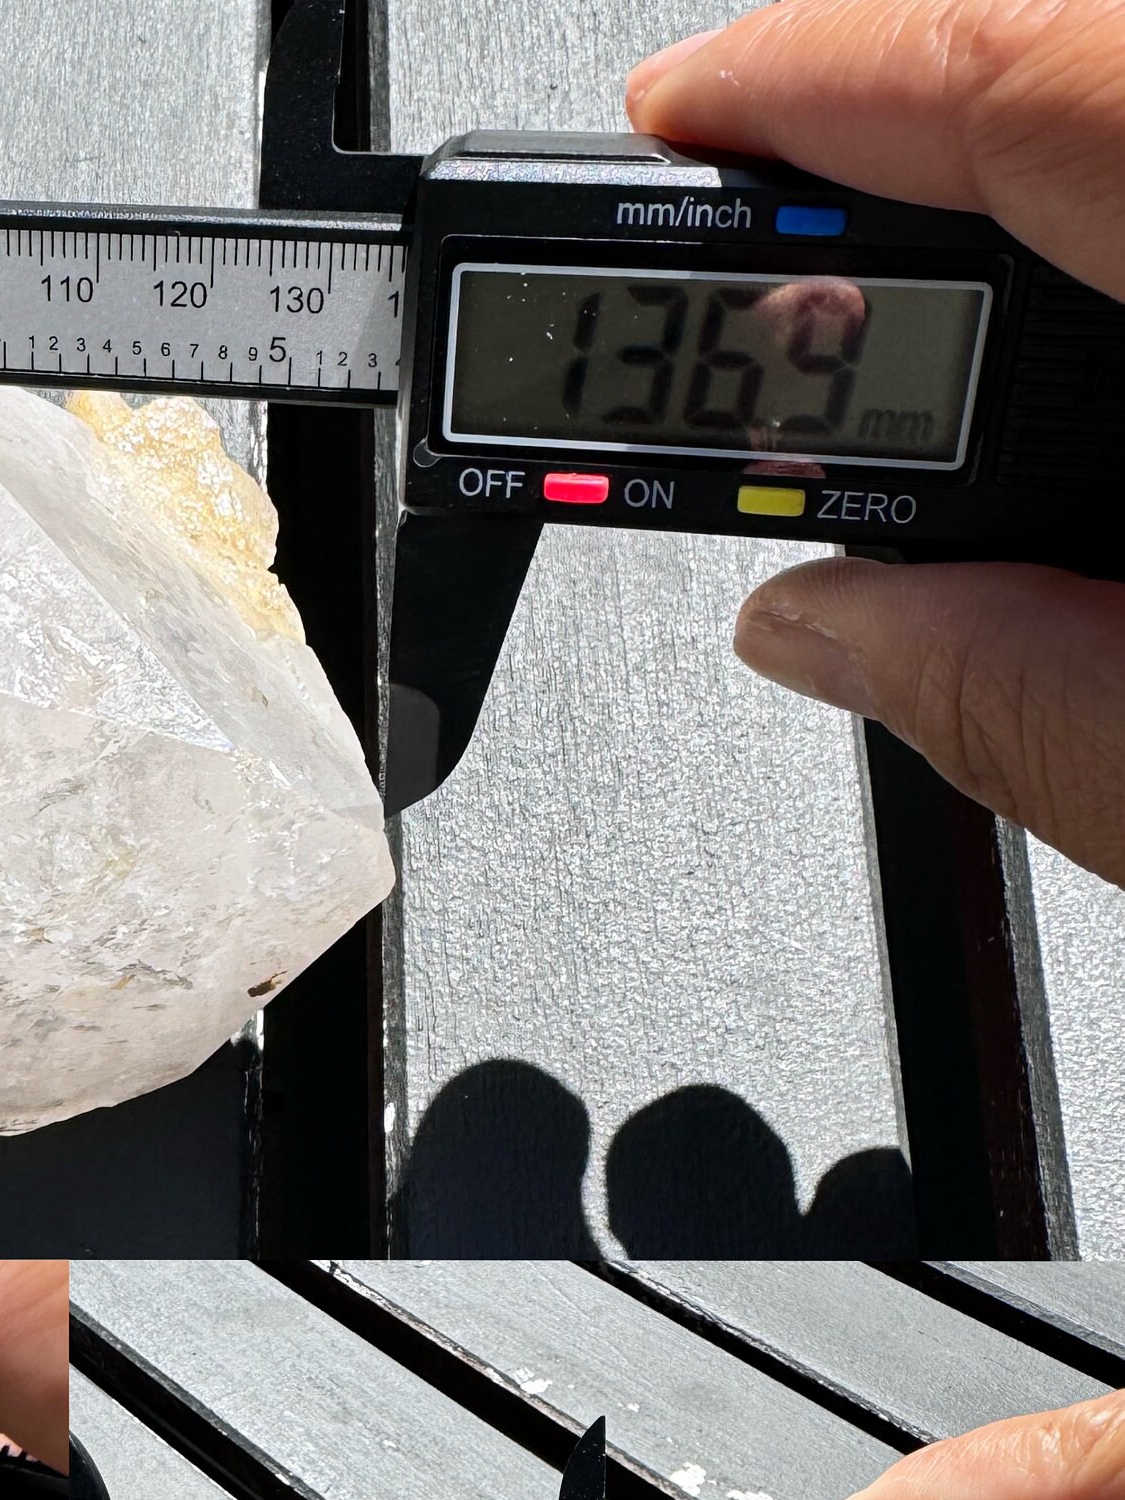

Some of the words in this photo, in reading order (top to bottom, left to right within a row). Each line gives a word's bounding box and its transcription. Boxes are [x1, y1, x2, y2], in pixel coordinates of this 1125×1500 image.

[617, 196, 750, 227] mm/inch
[41, 274, 93, 303] 110
[153, 280, 207, 309] 120
[270, 285, 324, 314] 130
[28, 335, 35, 350] 1
[49, 336, 58, 351] 2
[76, 337, 86, 352] 3
[102, 339, 112, 353] 4
[132, 341, 142, 355] 5
[160, 342, 171, 357] 6
[189, 343, 199, 358] 7
[218, 345, 228, 360] 8
[248, 346, 258, 361] 9
[269, 336, 286, 363] 5
[316, 350, 323, 366] 1
[337, 351, 348, 367] 2
[368, 353, 377, 368] 3
[861, 408, 933, 440] mm
[460, 468, 525, 498] OFF
[625, 480, 673, 508] ON
[817, 490, 917, 524] ZERO
